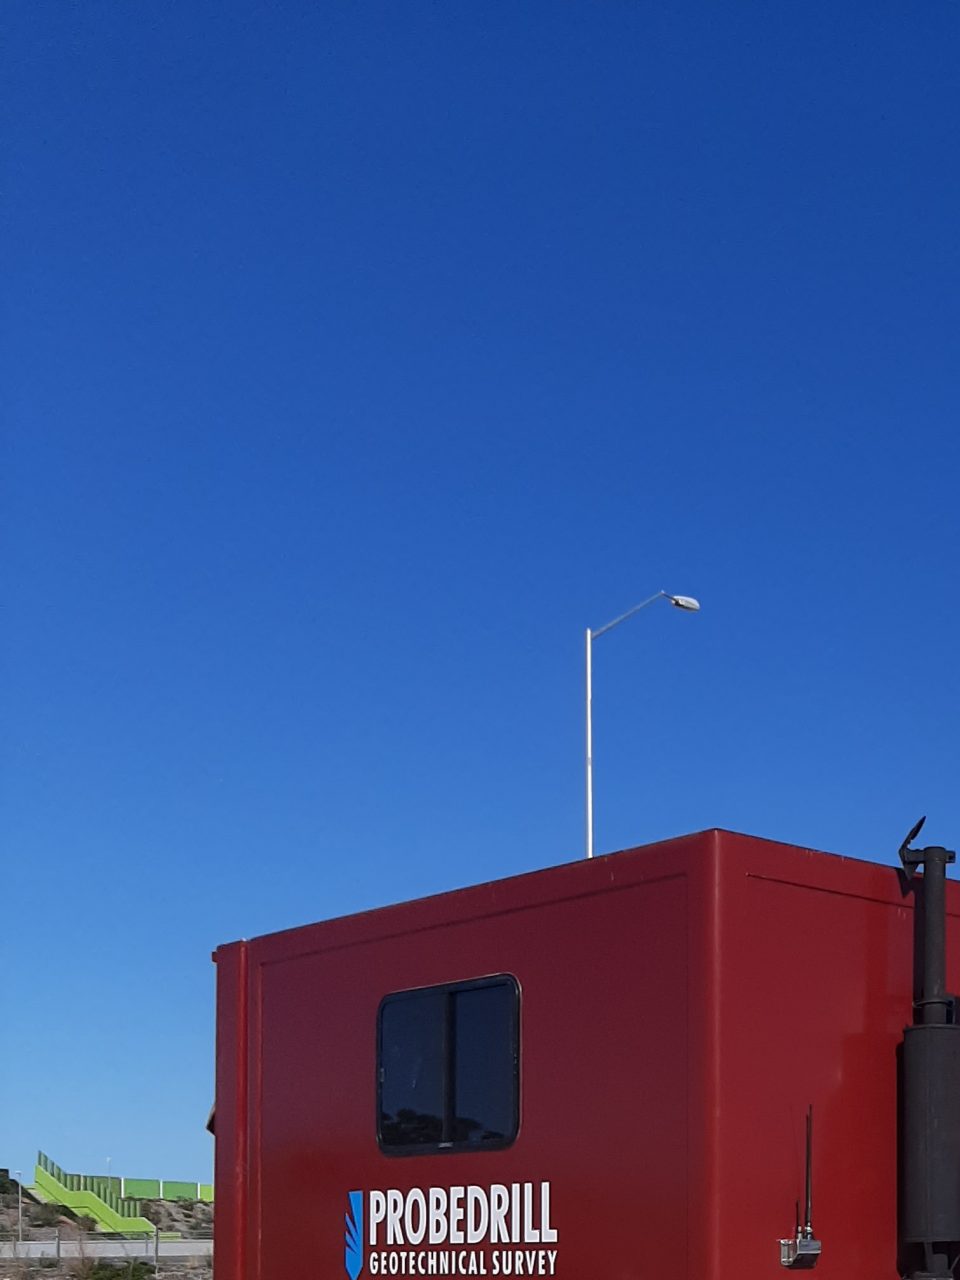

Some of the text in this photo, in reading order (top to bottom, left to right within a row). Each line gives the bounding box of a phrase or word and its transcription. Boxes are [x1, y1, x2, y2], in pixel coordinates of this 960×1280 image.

[369, 1181, 558, 1245] PROBEDRILL
[369, 1250, 558, 1275] GEOTECHNICAL SURVEY
